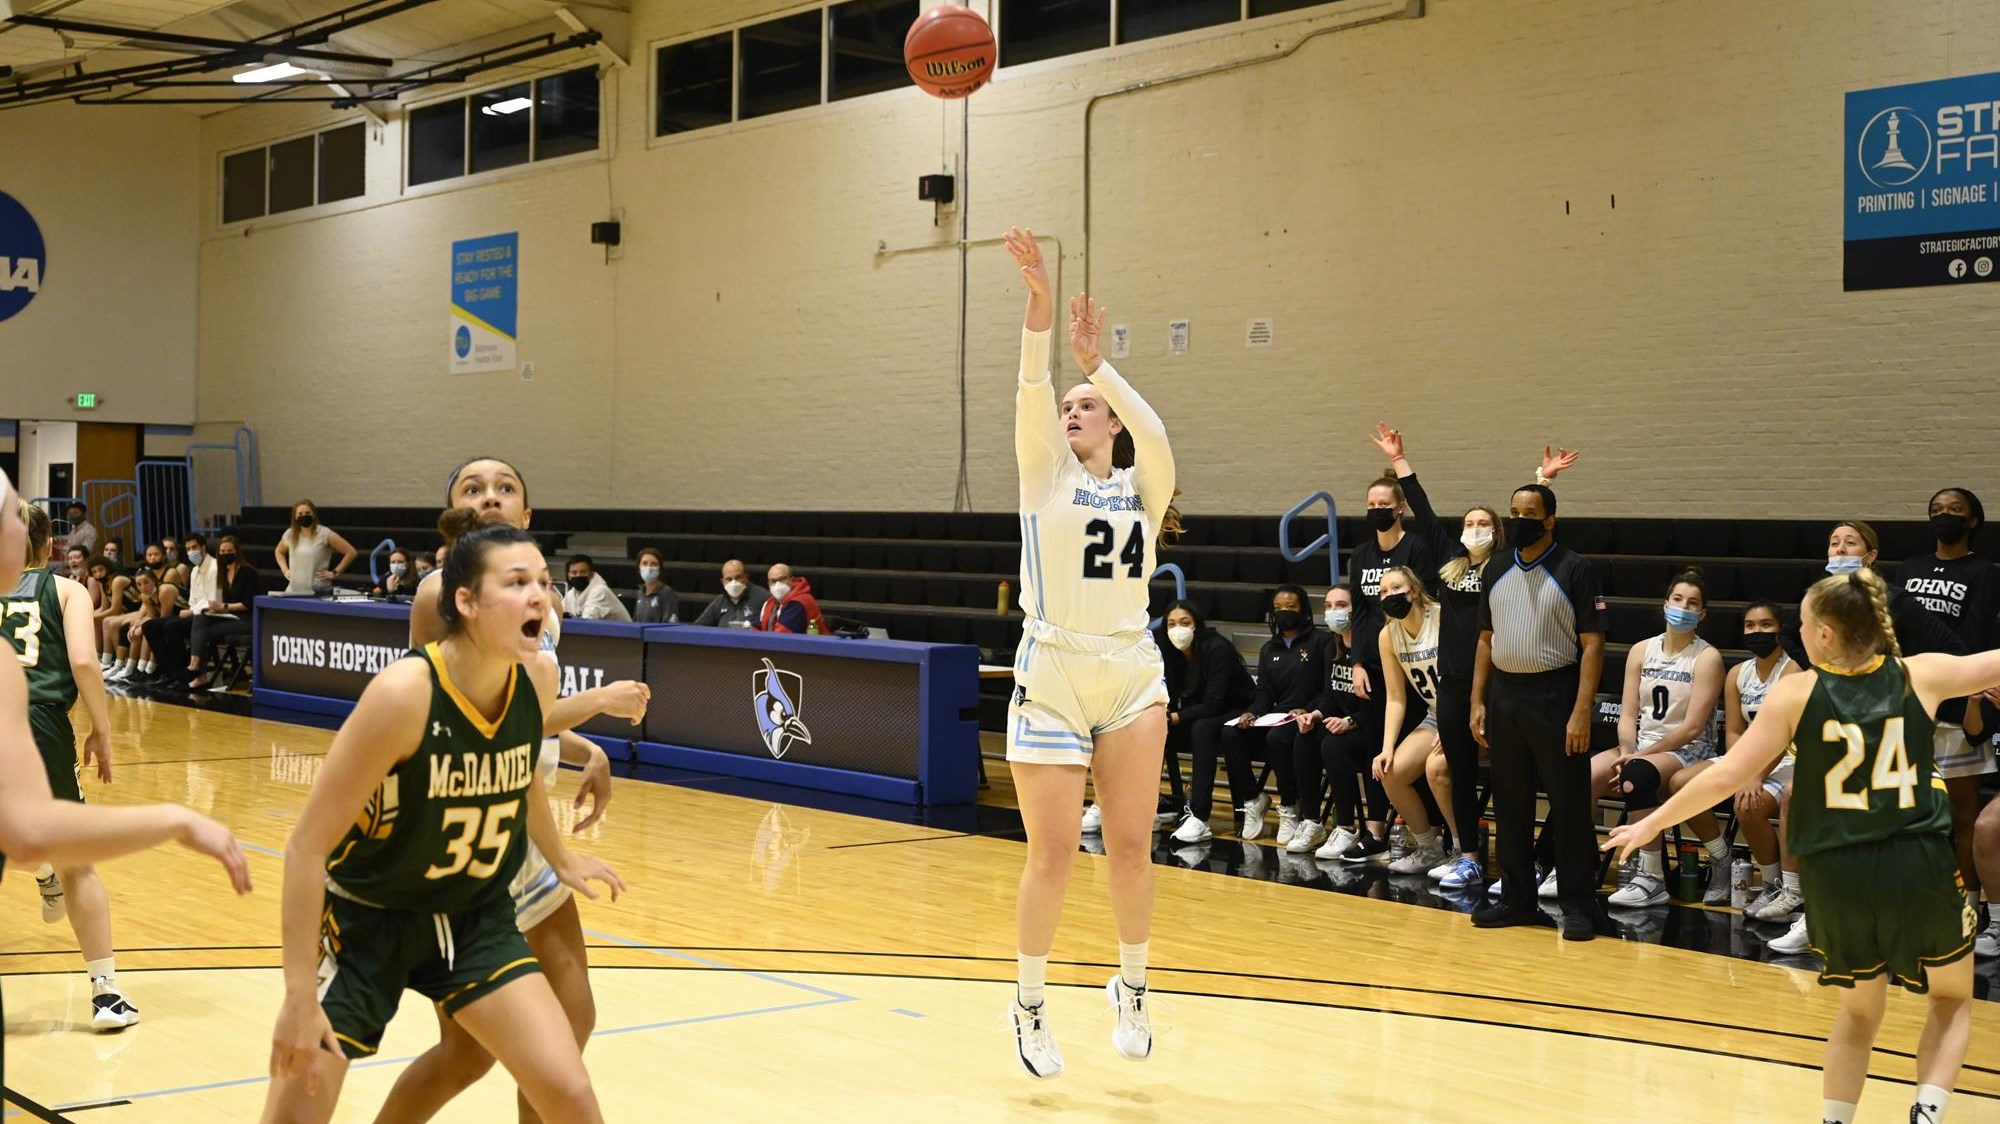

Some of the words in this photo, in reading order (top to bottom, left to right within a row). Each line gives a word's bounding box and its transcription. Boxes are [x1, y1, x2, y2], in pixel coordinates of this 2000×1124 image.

[926, 57, 985, 77] Wilson
[1858, 192, 1915, 213] PRINTING
[1931, 184, 1987, 207] SIGNAGE
[457, 252, 474, 265] STAY
[476, 247, 504, 262] RESTED
[1920, 236, 2000, 254] STRATEGICFACTOR
[455, 271, 479, 284] READY
[480, 268, 496, 280] FOR
[498, 264, 513, 277] THE
[78, 394, 95, 407] EXIT
[1083, 518, 1144, 579] 24
[272, 635, 325, 667] JOHNS
[1652, 685, 1669, 720] 0
[428, 743, 533, 799] McDANIEL
[1823, 717, 1918, 811] 24
[424, 799, 520, 879] 35
